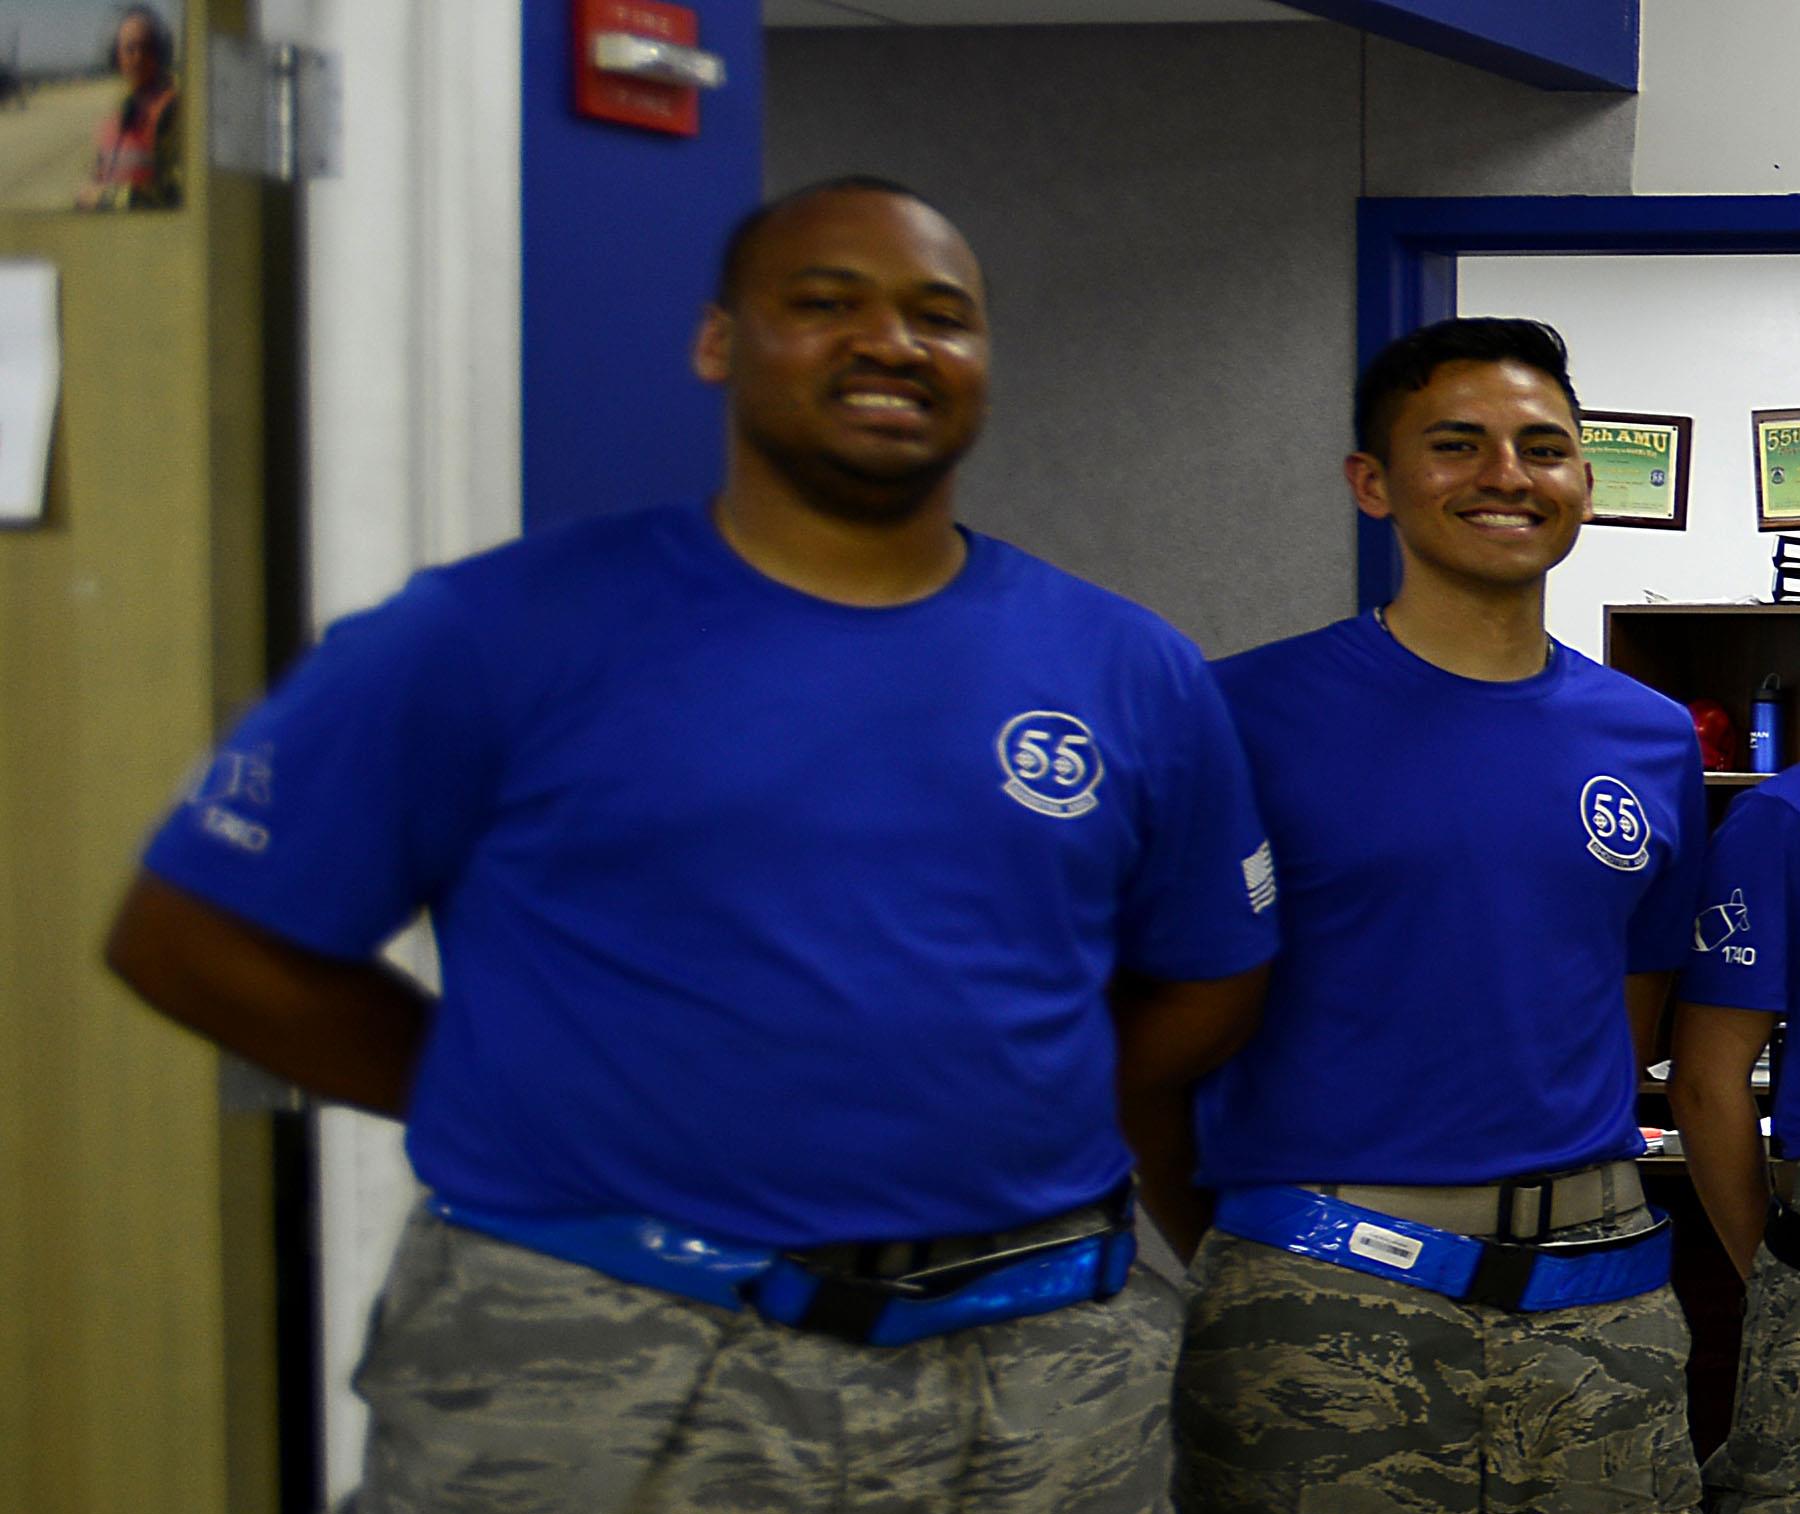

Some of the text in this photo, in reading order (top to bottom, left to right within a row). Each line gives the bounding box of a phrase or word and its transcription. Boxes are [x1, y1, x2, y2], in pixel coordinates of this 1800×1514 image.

[1616, 429, 1669, 453] AMU
[1017, 730, 1088, 786] 55
[1593, 793, 1639, 842] 55
